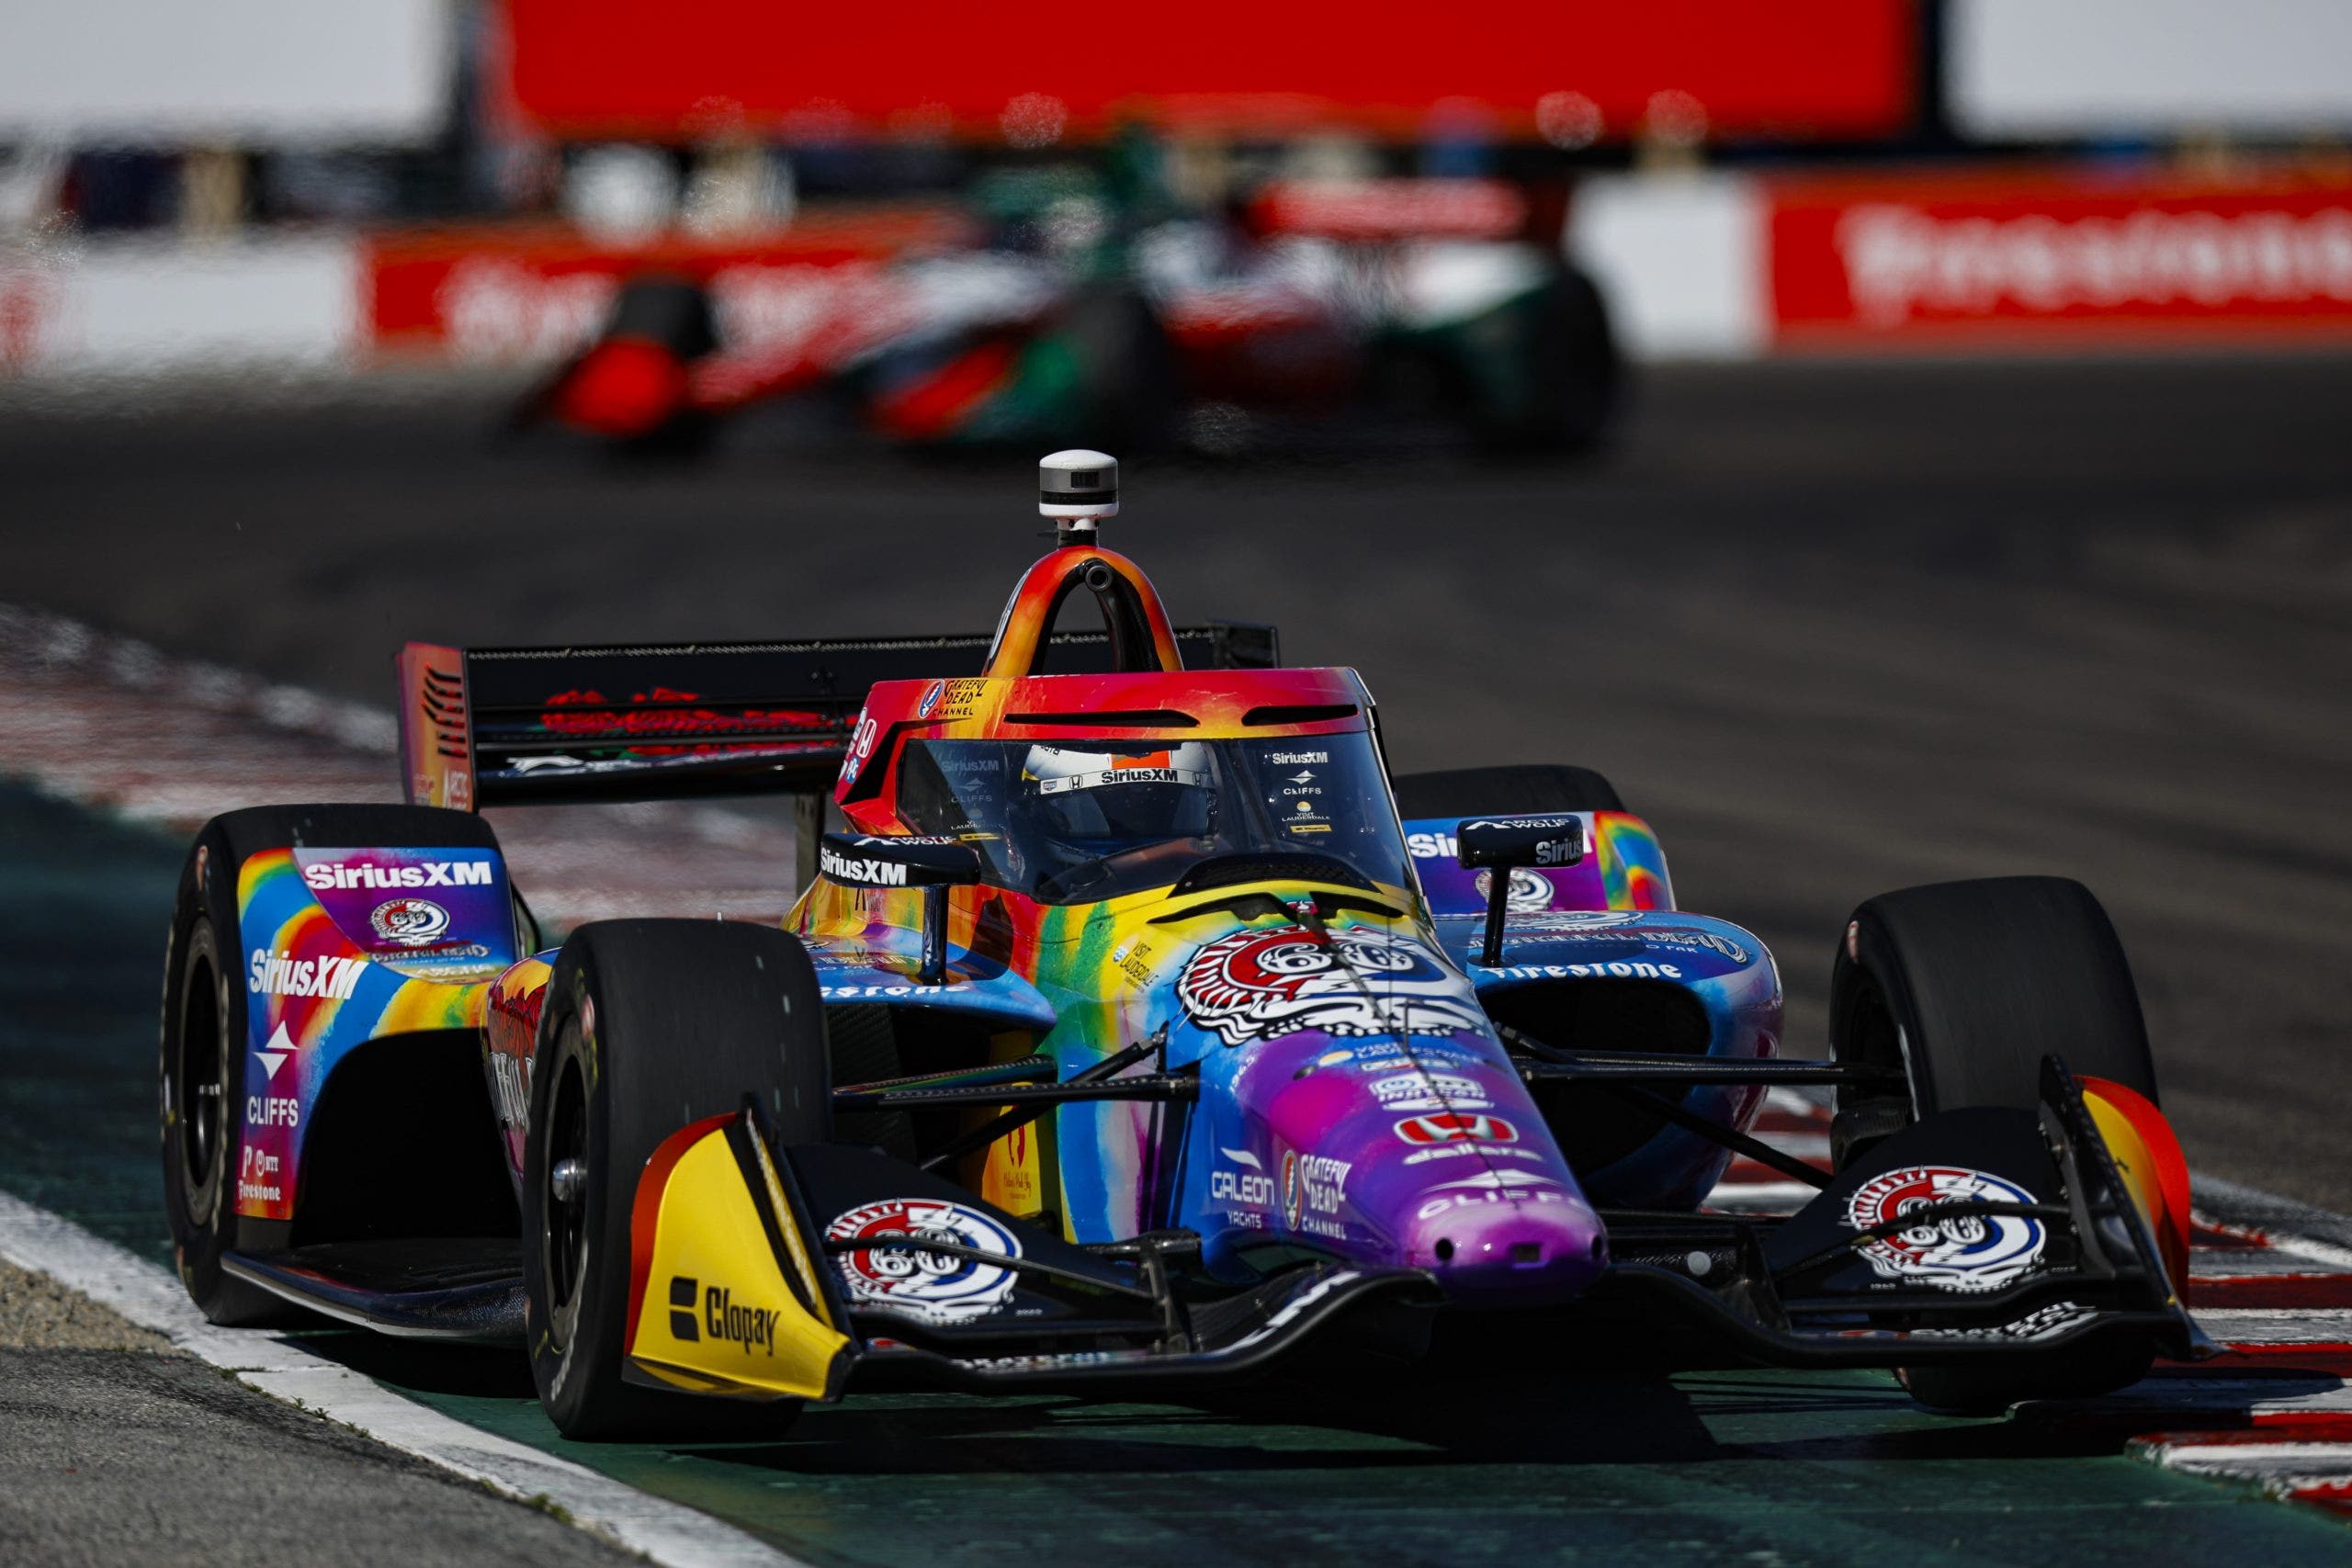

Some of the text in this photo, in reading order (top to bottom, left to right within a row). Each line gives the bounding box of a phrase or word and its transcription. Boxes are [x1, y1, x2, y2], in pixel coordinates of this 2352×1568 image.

[944, 679, 989, 697] GRATEFUL
[945, 692, 974, 705] DEAD
[932, 707, 974, 716] CHANNEL
[1272, 751, 1329, 765] SiriusXM
[1102, 769, 1179, 784] SiriusXM
[1283, 787, 1323, 795] CLIFFS
[1535, 838, 1582, 864] Sirius
[304, 861, 493, 890] SiriusXM
[820, 847, 907, 885] SiriusXM
[249, 948, 369, 1000] SiriusXM
[1479, 960, 1682, 979] Firestone
[247, 1095, 299, 1128] CLIFFS
[238, 1179, 281, 1201] Firestone
[1212, 1170, 1275, 1206] GALEON
[1300, 1154, 1352, 1202] GRATEFUL
[1310, 1182, 1339, 1214] DEAD
[1227, 1211, 1262, 1229] YACHTS
[1301, 1215, 1347, 1240] CHANNEL
[706, 1286, 781, 1358] Clopay
